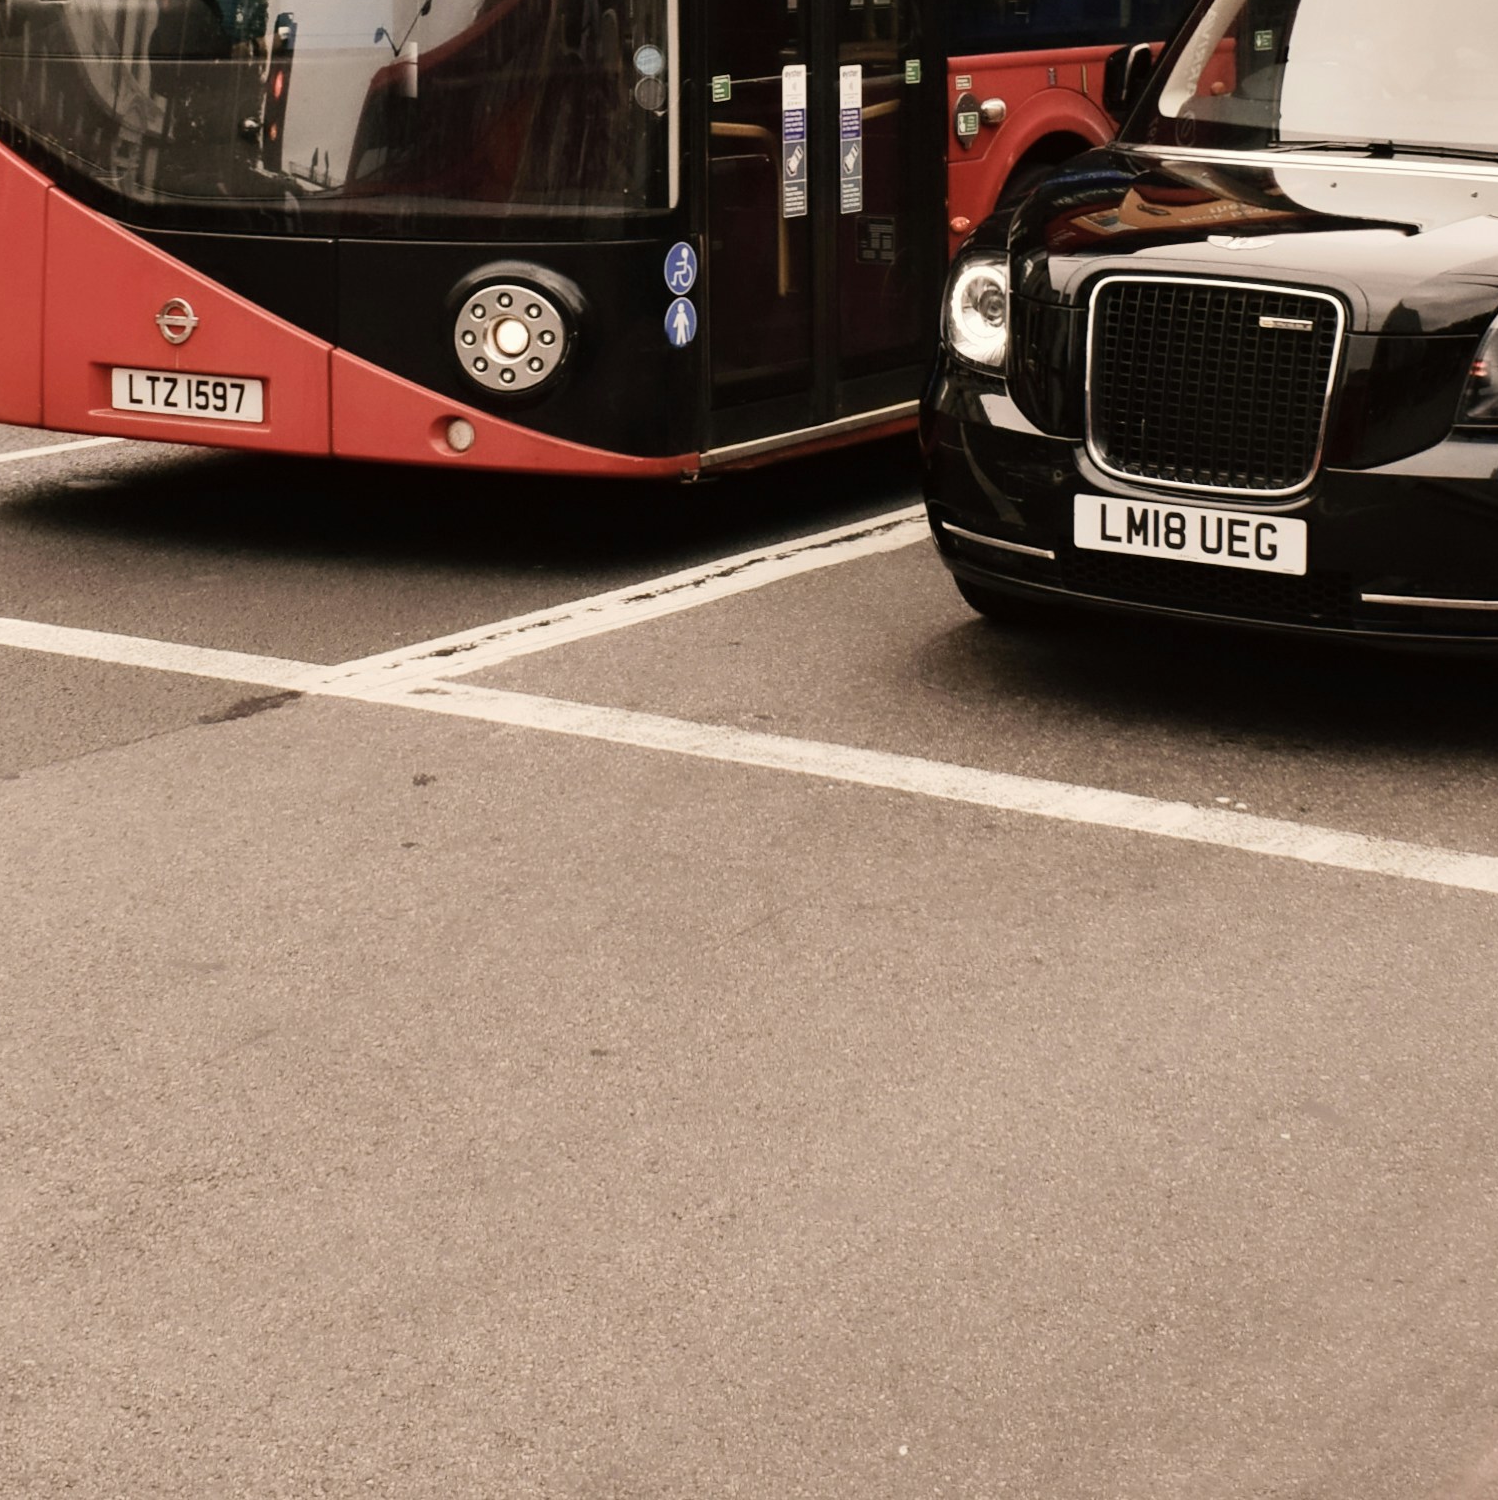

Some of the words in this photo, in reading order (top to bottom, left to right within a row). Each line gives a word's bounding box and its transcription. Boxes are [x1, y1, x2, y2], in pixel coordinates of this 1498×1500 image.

[128, 373, 179, 408] LTZ
[186, 378, 246, 413] 1597
[1100, 503, 1186, 550] LM18
[1201, 515, 1277, 561] UEG
